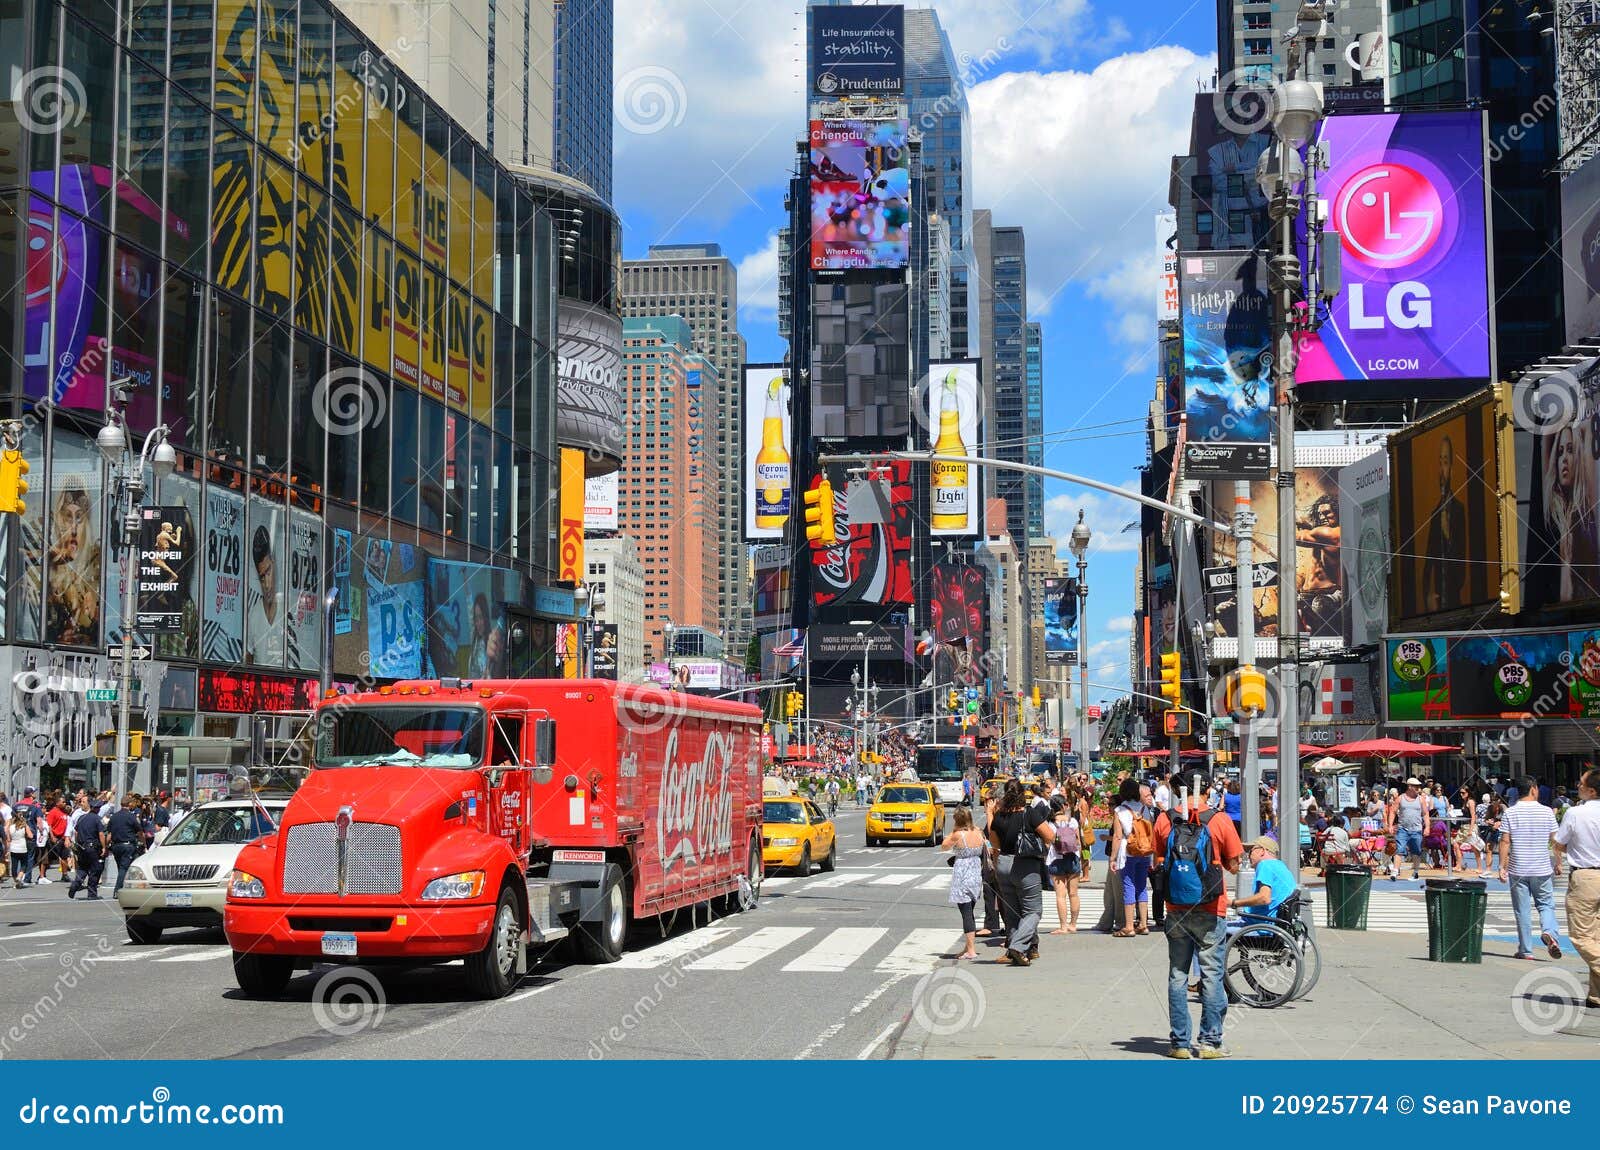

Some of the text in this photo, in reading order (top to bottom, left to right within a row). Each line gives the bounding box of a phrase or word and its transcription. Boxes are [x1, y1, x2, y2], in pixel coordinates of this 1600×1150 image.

[822, 29, 895, 37] Life Insurance is
[824, 41, 894, 58] stability.
[840, 78, 901, 90] Prudential
[812, 131, 866, 142] Chengdu,
[411, 178, 447, 248] THE
[371, 213, 430, 334] LION
[1191, 292, 1225, 317] Harry
[1348, 281, 1432, 330] LG
[431, 260, 486, 370] KING
[1368, 359, 1419, 371] LG.COM
[687, 389, 699, 493] NOVOTEL
[1188, 447, 1233, 459] Discovery
[936, 488, 964, 503] Light
[141, 551, 181, 559] POMPEII
[208, 528, 240, 576] 8/28
[141, 567, 160, 575] THE
[292, 549, 318, 593] 8/28
[140, 583, 178, 591] EXHIBIT
[216, 576, 240, 596] SUNDAY
[1402, 643, 1421, 653] PBS
[1503, 665, 1524, 676] PBS
[89, 691, 96, 699] W
[98, 690, 109, 699] 44
